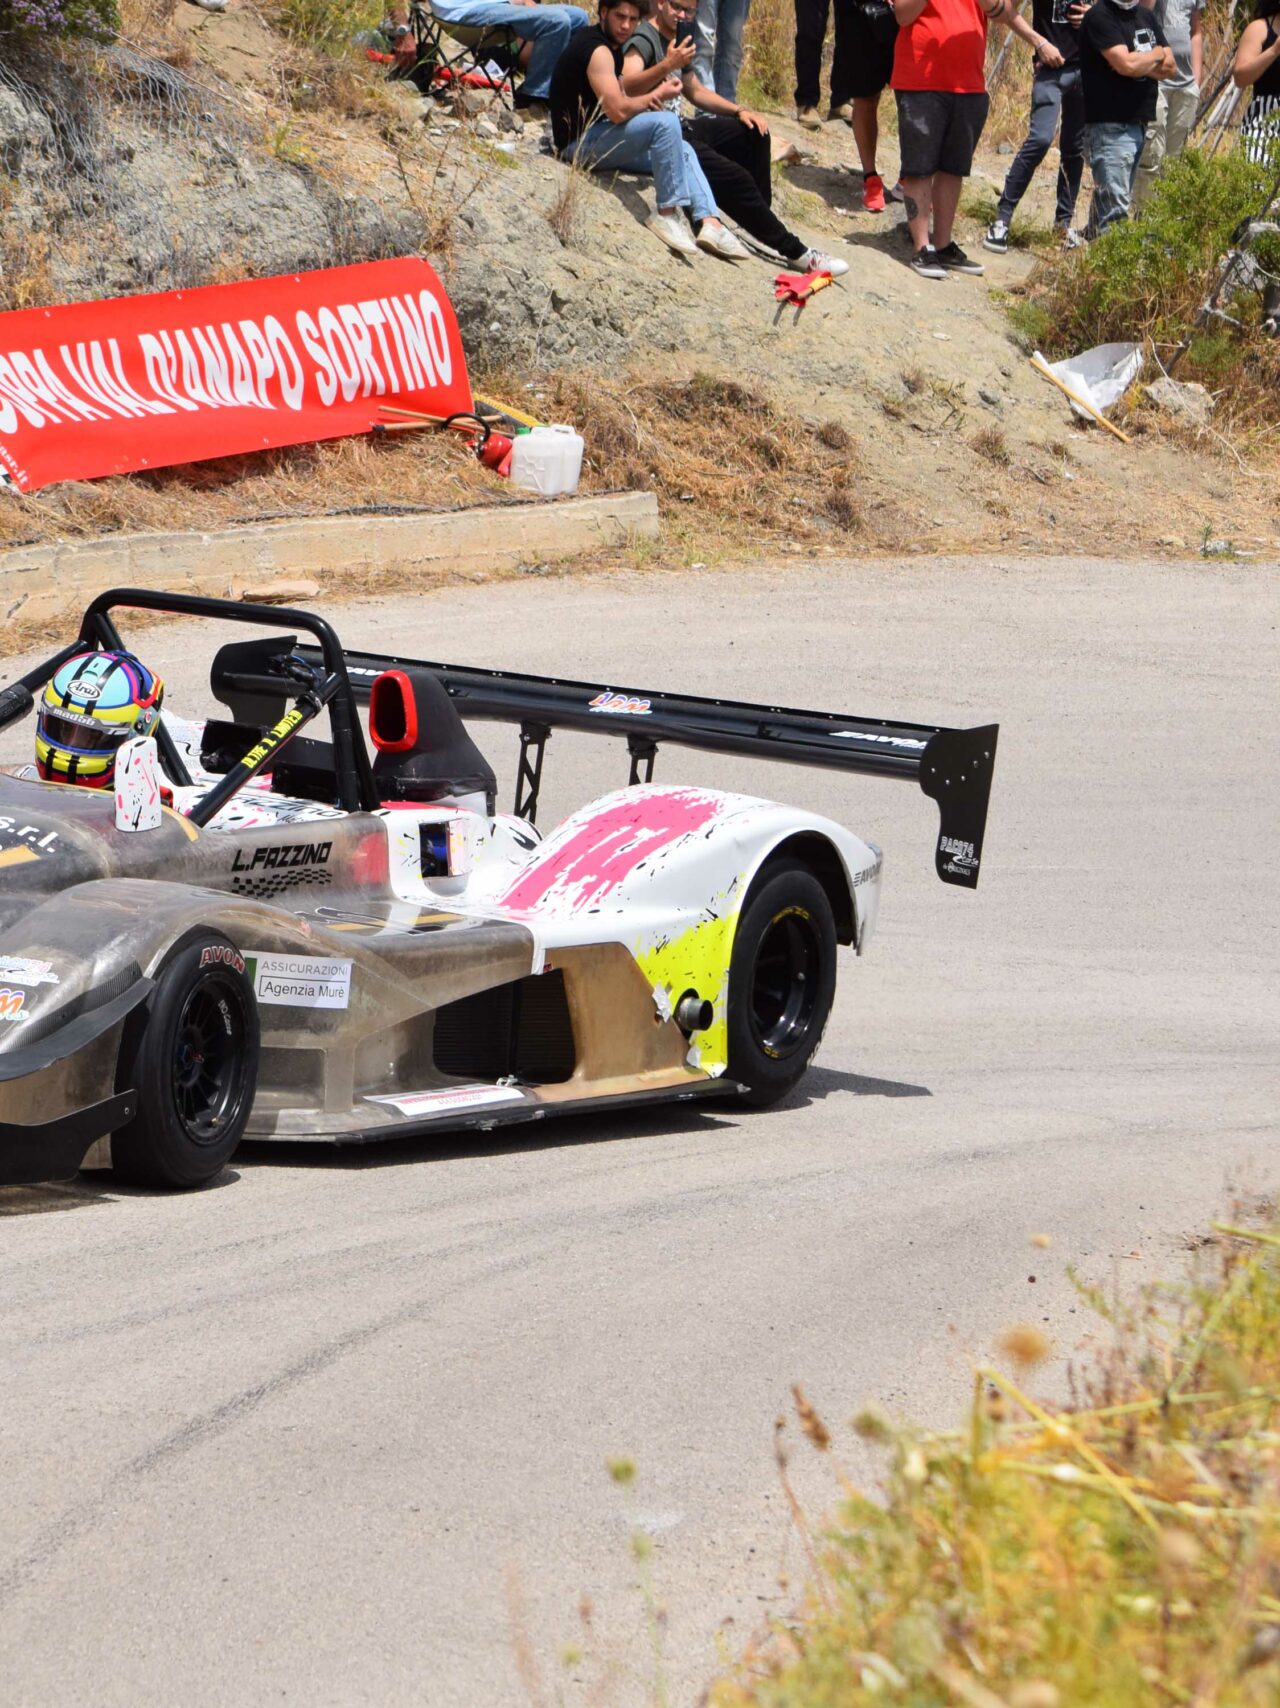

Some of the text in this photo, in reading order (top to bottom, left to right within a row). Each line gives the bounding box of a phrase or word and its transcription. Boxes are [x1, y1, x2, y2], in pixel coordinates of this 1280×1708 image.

[59, 338, 177, 418] VAL
[137, 315, 303, 411] D'ANAPO
[297, 289, 454, 407] SORTINO
[69, 681, 96, 696] Arai
[199, 945, 246, 975] AVON
[261, 960, 348, 976] ASSICURAZIONI
[264, 981, 345, 999] Agenzia Murè
